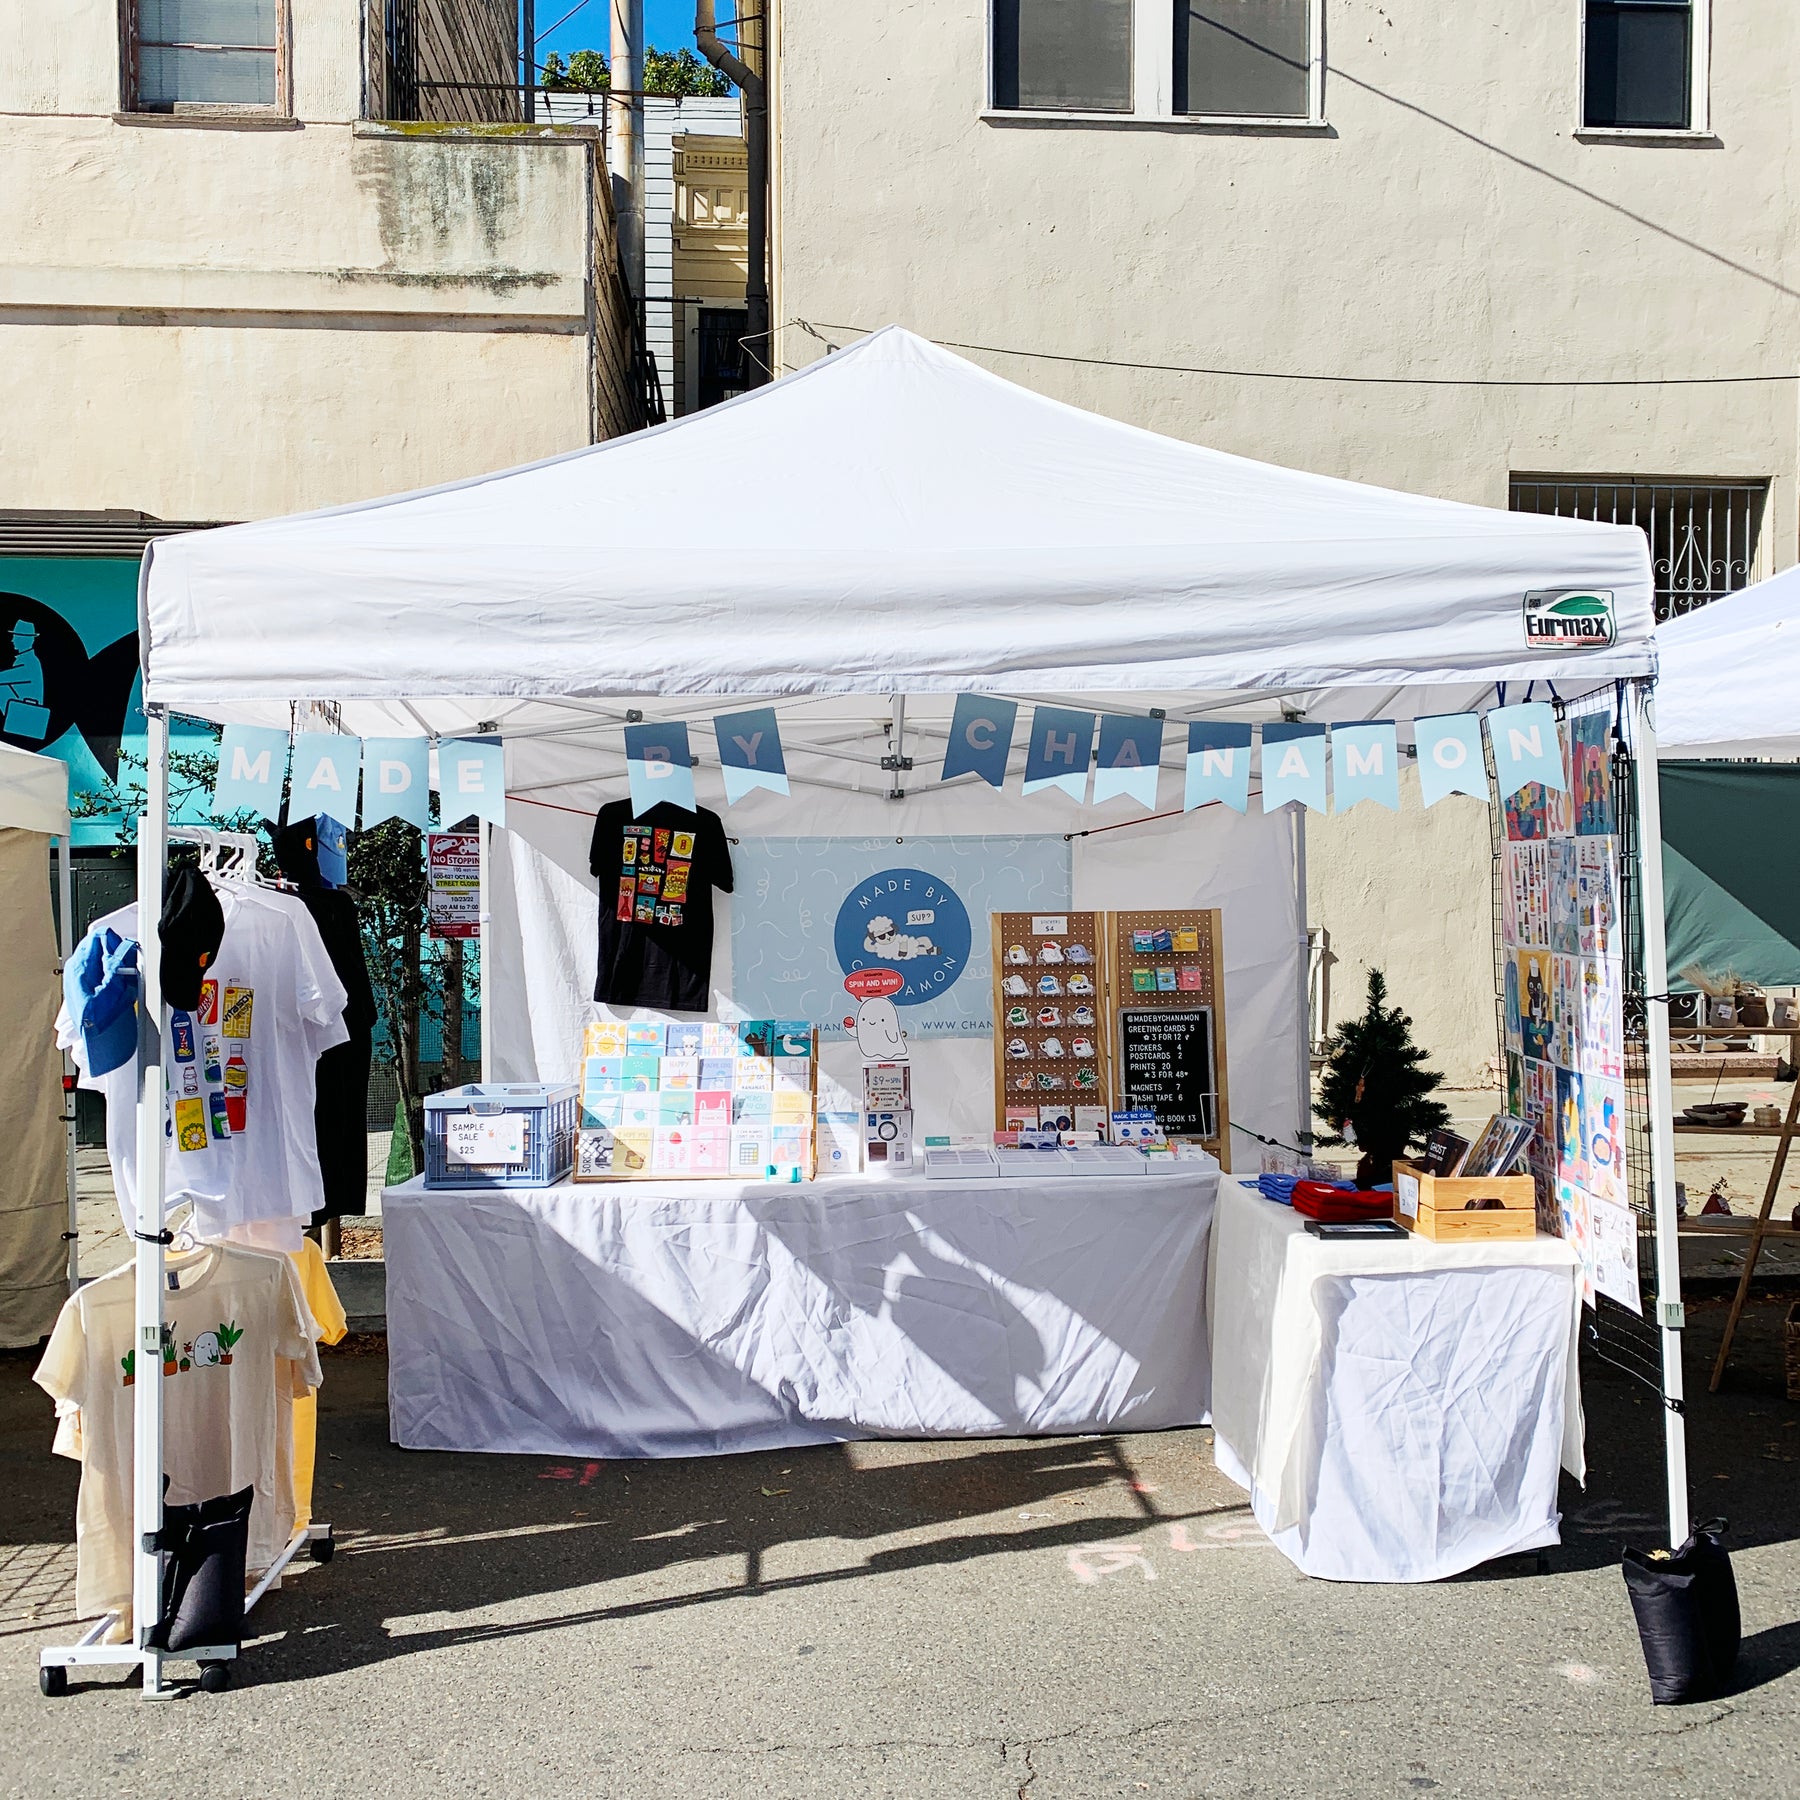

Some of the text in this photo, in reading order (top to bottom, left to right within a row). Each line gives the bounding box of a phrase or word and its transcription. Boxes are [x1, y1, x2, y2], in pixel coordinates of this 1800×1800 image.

[1526, 615, 1607, 637] Eurmax
[231, 716, 1544, 794] MADE BY CHANAMON
[432, 855, 480, 865] NO STOPPIN
[858, 879, 948, 909] MADE BY
[911, 913, 932, 922] SUP?
[848, 978, 898, 988] SPIN AND WIN!
[1127, 1014, 1200, 1022] @MADEBYCHANAMON
[705, 1025, 738, 1034] HAPPY
[1128, 1024, 1195, 1033] GREETING CARDS 5
[704, 1035, 737, 1046] HAPPY
[704, 1047, 737, 1056] HAPPY
[1129, 1052, 1171, 1060] POSTCARDS
[669, 1060, 690, 1068] HAPPY
[1130, 1062, 1156, 1071] PRINTS
[872, 1075, 885, 1086] $9
[1130, 1083, 1163, 1091] MAGNETS
[1131, 1094, 1154, 1102] WASHI
[1166, 1114, 1186, 1122] BOOK
[452, 1123, 485, 1132] SAMPLE
[458, 1133, 479, 1141] SALE
[459, 1146, 475, 1154] $25
[1430, 1142, 1447, 1156] GHOST
[582, 1155, 592, 1174] SOR
